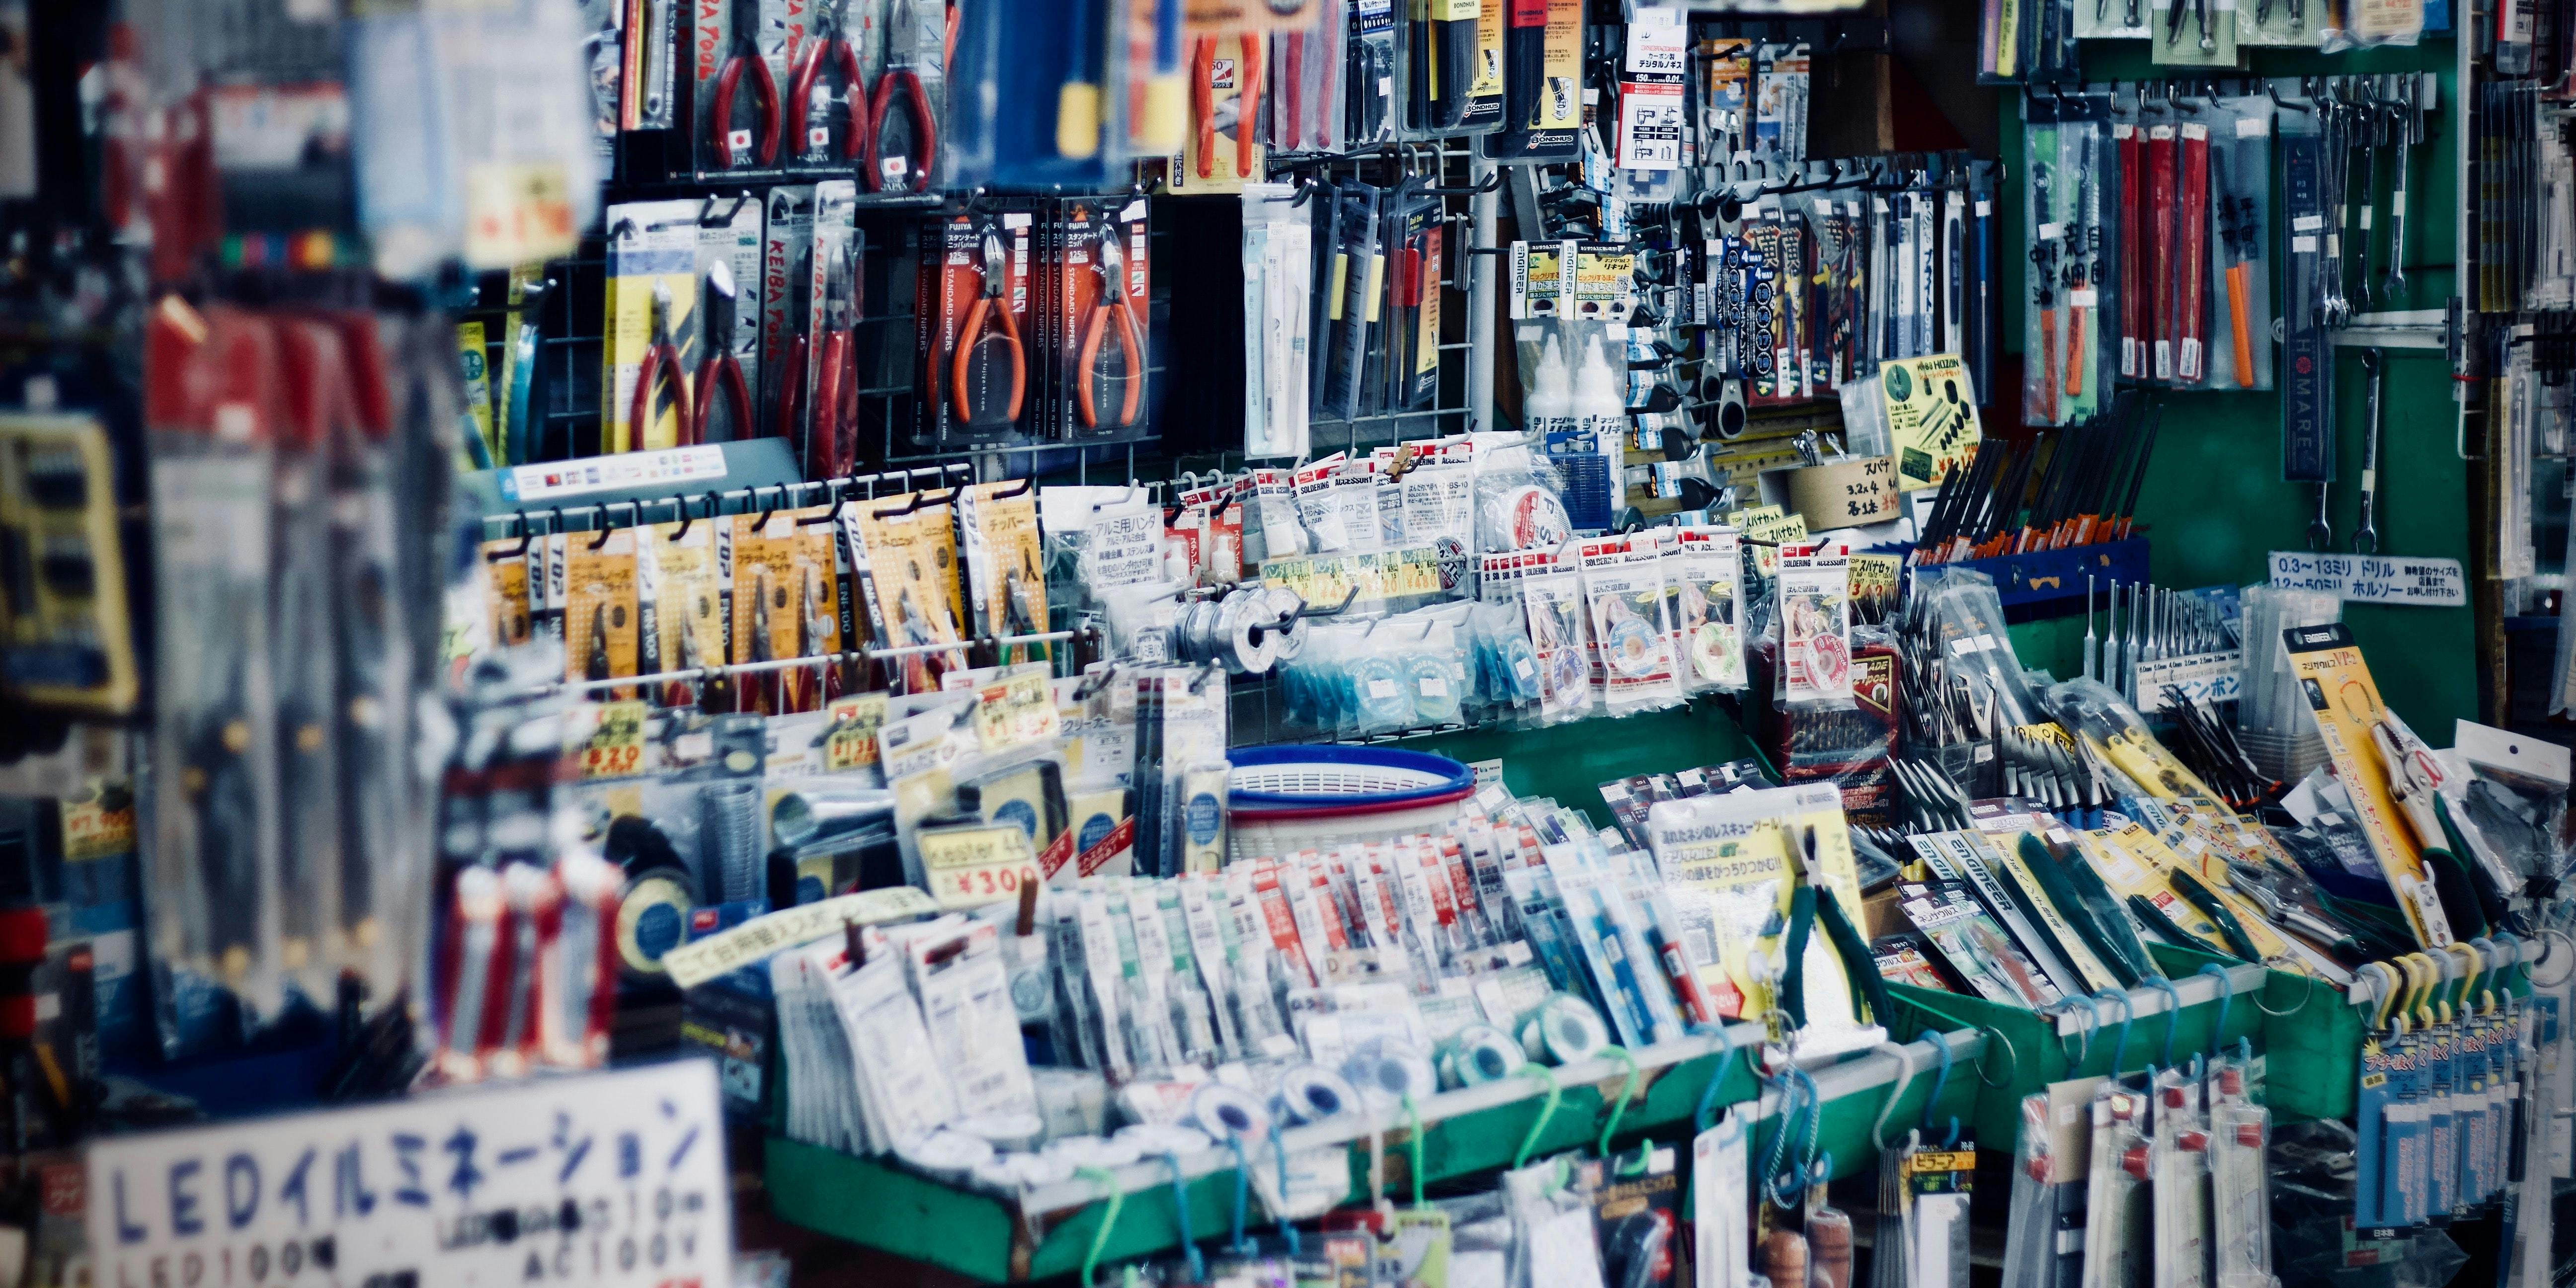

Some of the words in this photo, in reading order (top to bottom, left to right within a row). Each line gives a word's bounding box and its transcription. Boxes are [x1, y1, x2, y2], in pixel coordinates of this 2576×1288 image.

[1639, 60, 1682, 69] デジタルノギス
[948, 234, 980, 242] スタンダード
[1068, 232, 1097, 241] スタンダード
[946, 268, 955, 313] STANDARD
[1758, 335, 1769, 345] 17
[1864, 460, 1890, 476] スパナ
[1300, 481, 1329, 494] SOLDERING
[1096, 514, 1156, 537] アルミ用ハンダ
[1783, 559, 1811, 567] SOLDERING
[1859, 560, 1892, 573] スパナセッ
[2361, 560, 2395, 577] ドリル
[1526, 566, 1548, 576] SOLDERING
[2352, 579, 2403, 597] ホルソー
[1950, 839, 2013, 911] ENGINEER
[2364, 1053, 2416, 1071] プチ抜く
